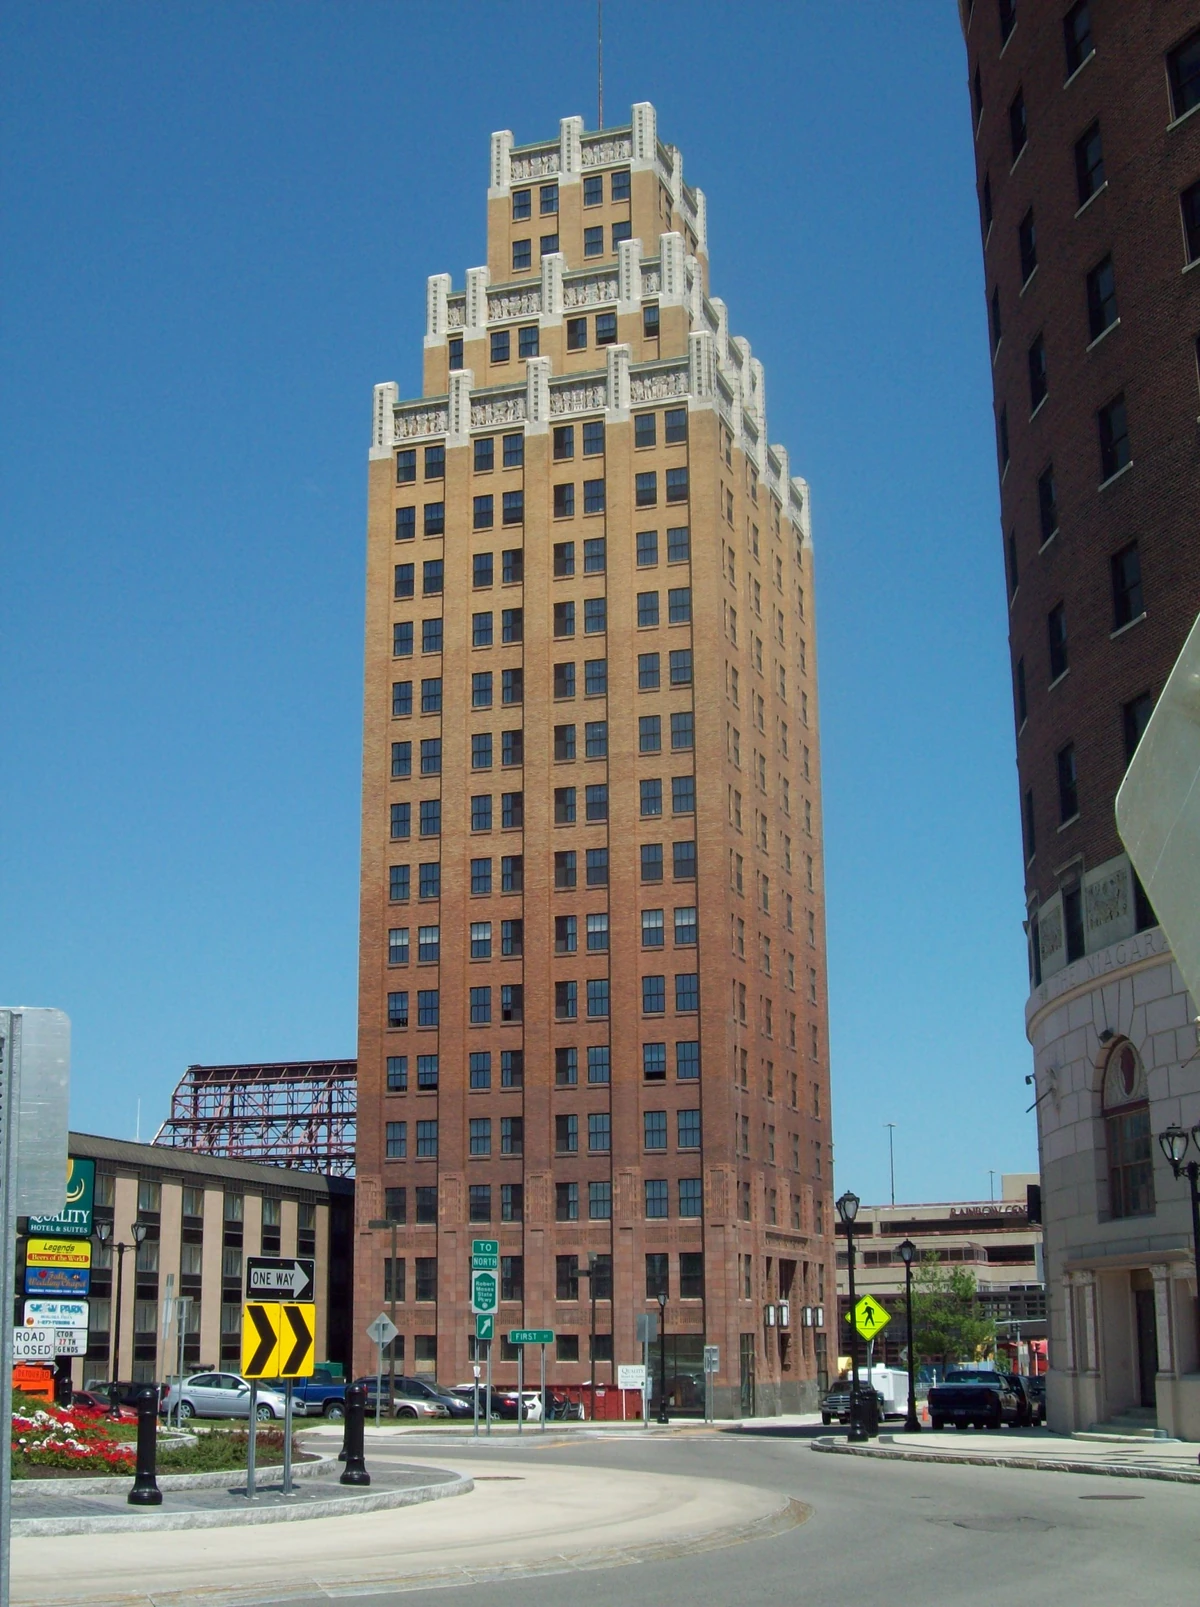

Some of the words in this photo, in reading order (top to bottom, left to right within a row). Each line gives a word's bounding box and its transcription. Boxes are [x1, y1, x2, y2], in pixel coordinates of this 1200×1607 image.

[950, 1205, 1002, 1216] RAINBOW
[43, 1242, 75, 1252] Legends
[480, 1243, 492, 1252] TO
[473, 1257, 497, 1266] NORTH
[28, 1278, 60, 1288] Wedding
[61, 1280, 86, 1289] Chapel
[252, 1271, 271, 1285] ONE
[276, 1272, 295, 1286] WAY
[30, 1303, 57, 1313] SNW
[60, 1304, 84, 1314] PARK
[15, 1331, 46, 1342] ROAD
[515, 1333, 537, 1341] FIRST
[17, 1369, 40, 1378] DETOUR
